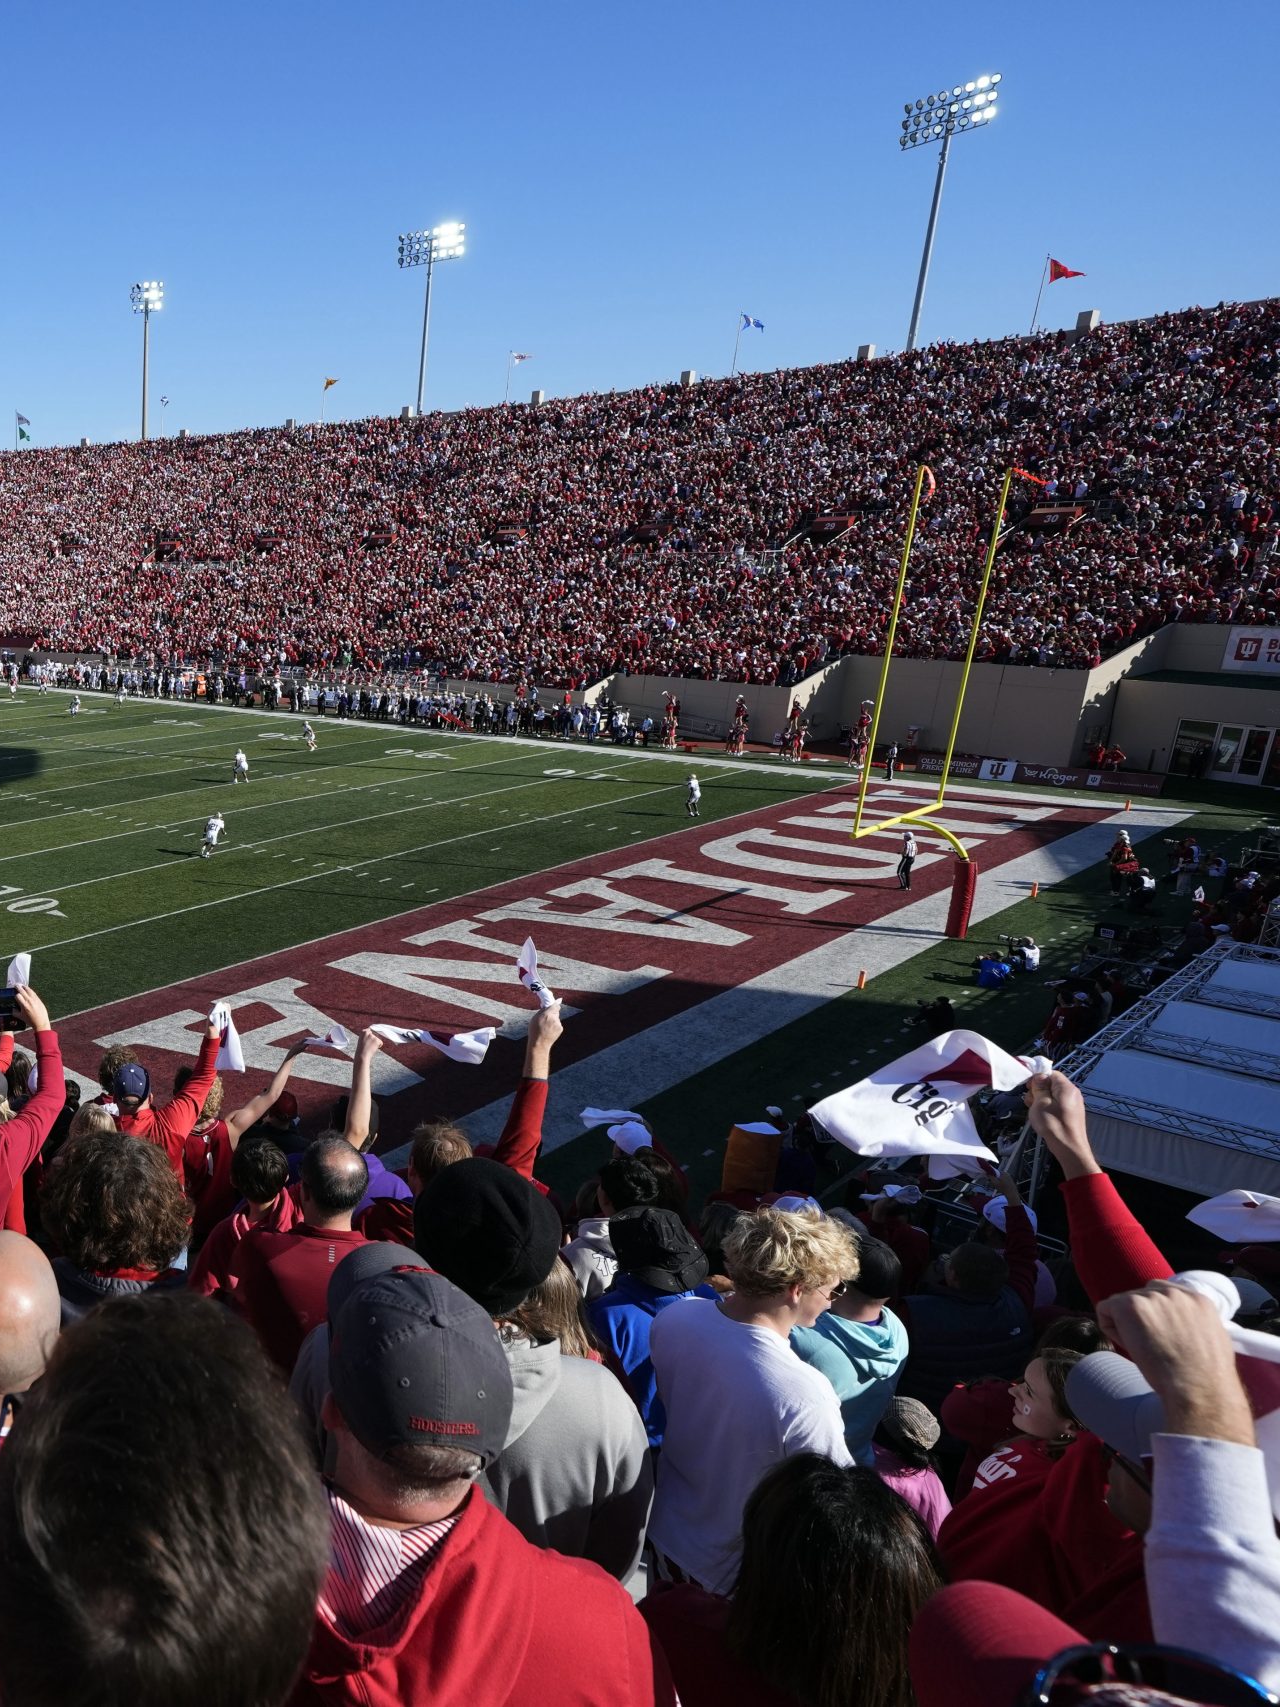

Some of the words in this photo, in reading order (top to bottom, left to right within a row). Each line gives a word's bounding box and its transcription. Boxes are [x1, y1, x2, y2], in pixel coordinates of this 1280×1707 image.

[1044, 513, 1059, 524] 30
[823, 521, 837, 530] 29
[920, 763, 955, 773] FREIGT
[921, 757, 937, 765] OLD
[937, 759, 979, 768] DMINION
[1039, 767, 1079, 786] Kroger
[408, 1415, 481, 1436] HOOSIERS
